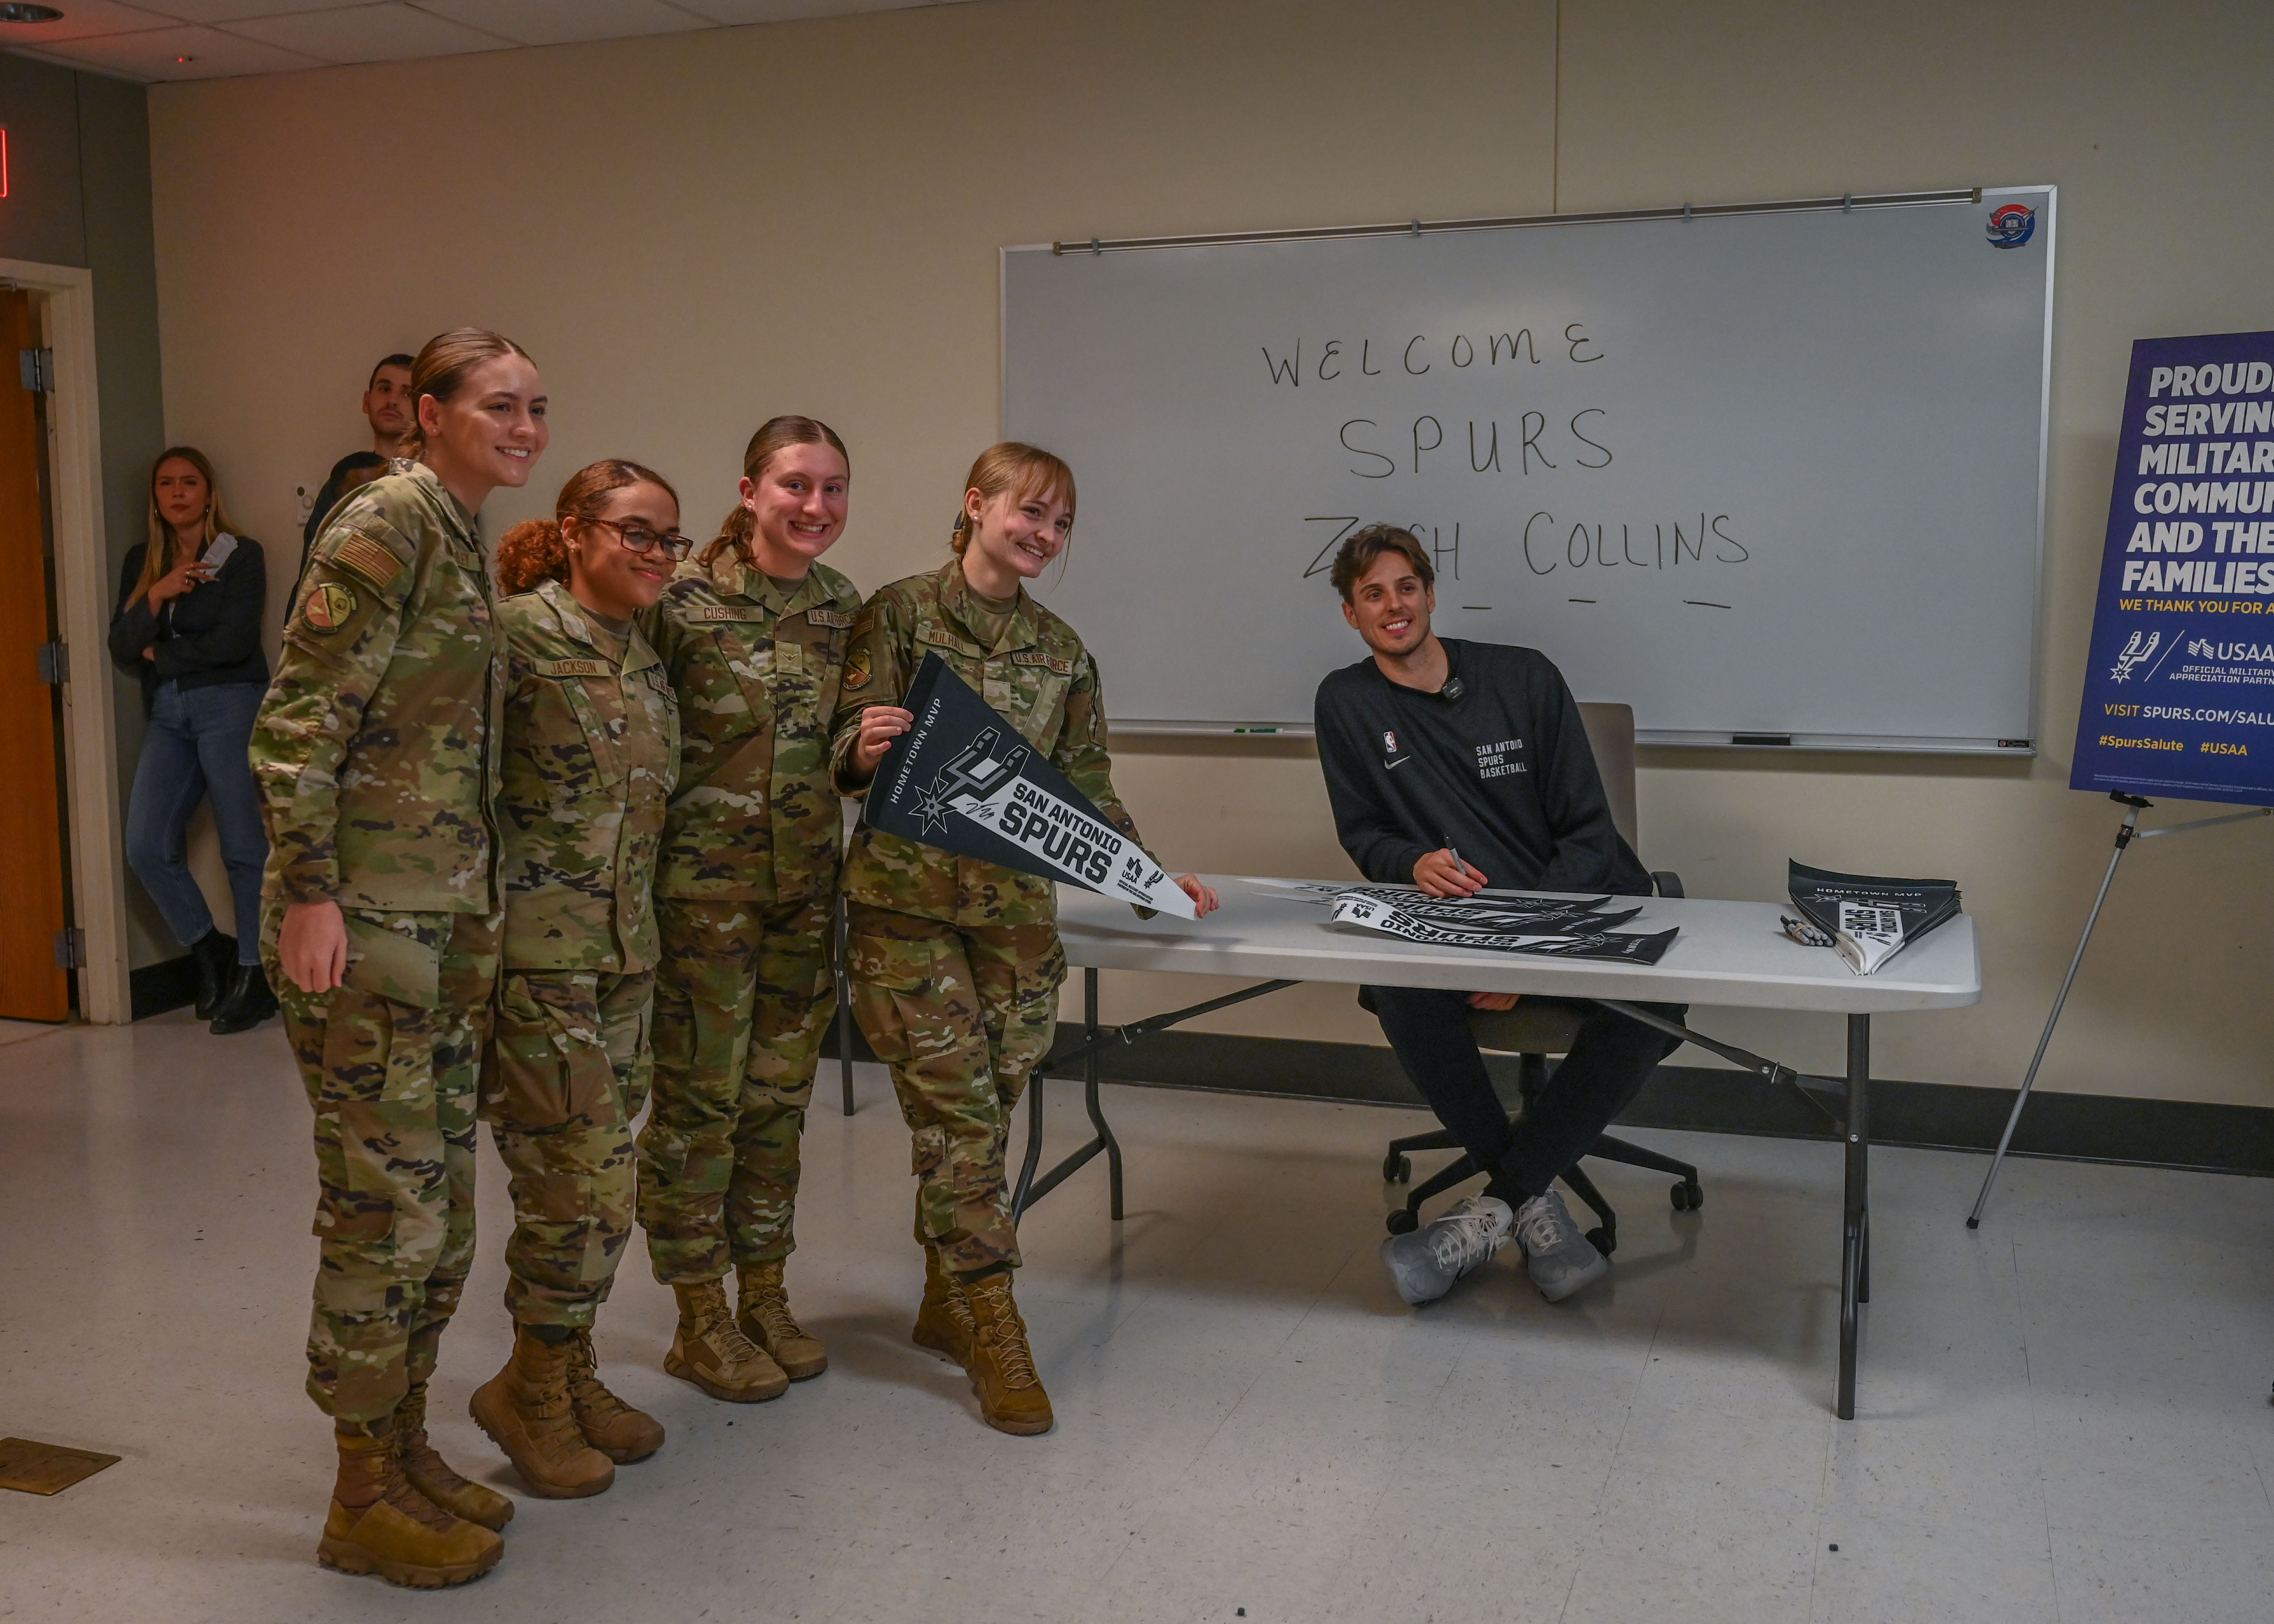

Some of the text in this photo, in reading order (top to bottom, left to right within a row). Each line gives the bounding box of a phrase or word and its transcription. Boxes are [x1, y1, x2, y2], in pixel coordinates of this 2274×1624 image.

[1262, 323, 1605, 387] WELCOME
[2148, 361, 2274, 398] PROUD
[2142, 401, 2274, 437] SERVIN
[1340, 408, 1613, 479] SPURS
[2138, 441, 2274, 475] MILITAR
[1303, 511, 1749, 581] ZH COLLINS
[2125, 522, 2274, 554] AND THE
[2121, 561, 2274, 595] FAMILIES
[704, 608, 746, 621] CUSHING
[2120, 599, 2142, 611] WE
[2146, 599, 2194, 612] THANK
[2199, 601, 2229, 613] YOU
[2232, 602, 2263, 614] FOR
[929, 631, 967, 653] MULHALL
[2217, 643, 2274, 662] USAA
[551, 660, 597, 674] JACKSON
[1046, 655, 1069, 672] FORCE
[2182, 665, 2226, 674] OFFICIAL
[2169, 673, 2240, 683] APPRECIATION
[2104, 703, 2140, 717] VISIT
[890, 697, 942, 804] HOMETOWN MVP
[1476, 738, 1522, 756] SAN ANTOO
[2099, 735, 2248, 756] #SpursSalute #USAA
[1478, 754, 1504, 767] SPURS
[1480, 762, 1527, 779] BASKETBALL
[1013, 783, 1050, 814] SAN
[1048, 804, 1122, 855] ANTONIO
[999, 801, 1113, 884] SPURS
[1122, 870, 1137, 884] USAA
[1817, 888, 1889, 896] HOMETOWN
[1356, 903, 1375, 911] USAA
[1380, 919, 1467, 943] ANTONIO
[1388, 910, 1521, 943] SPURS
